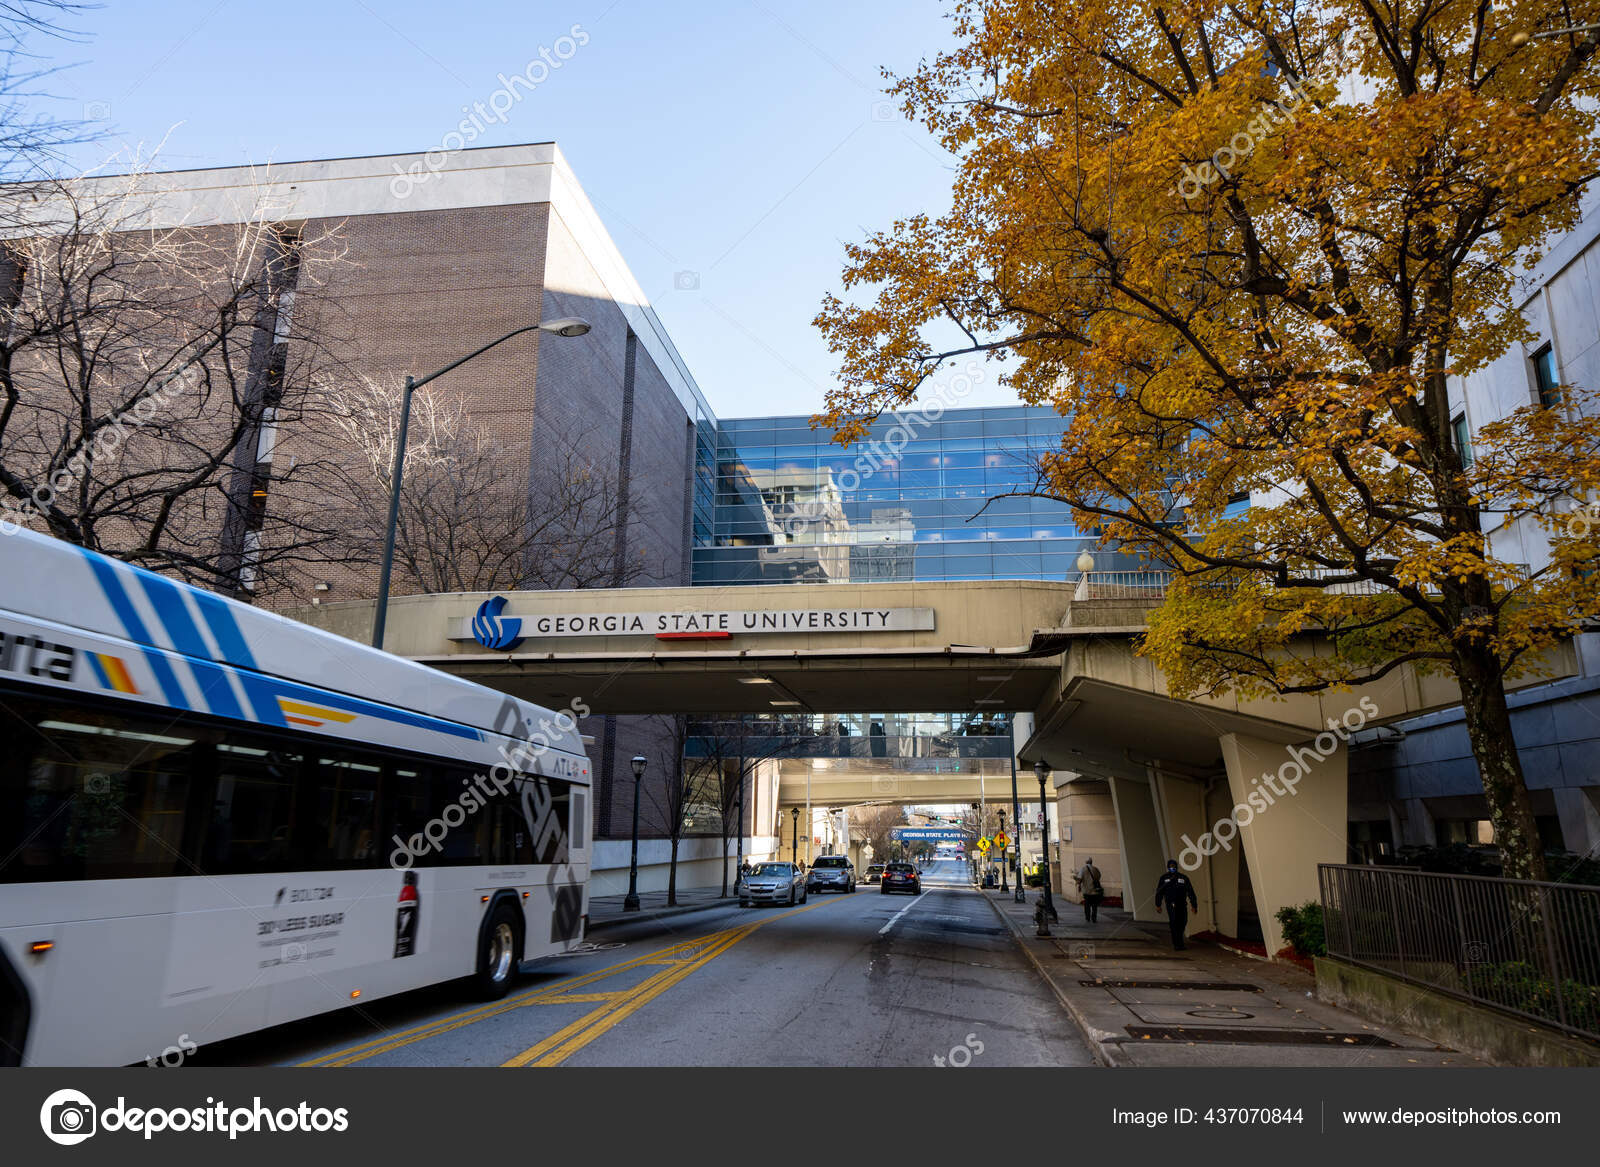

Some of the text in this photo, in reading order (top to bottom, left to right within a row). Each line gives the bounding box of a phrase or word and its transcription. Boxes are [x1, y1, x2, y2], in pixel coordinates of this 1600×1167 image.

[537, 611, 890, 633] GEORGIA STATE UNIVERSITY
